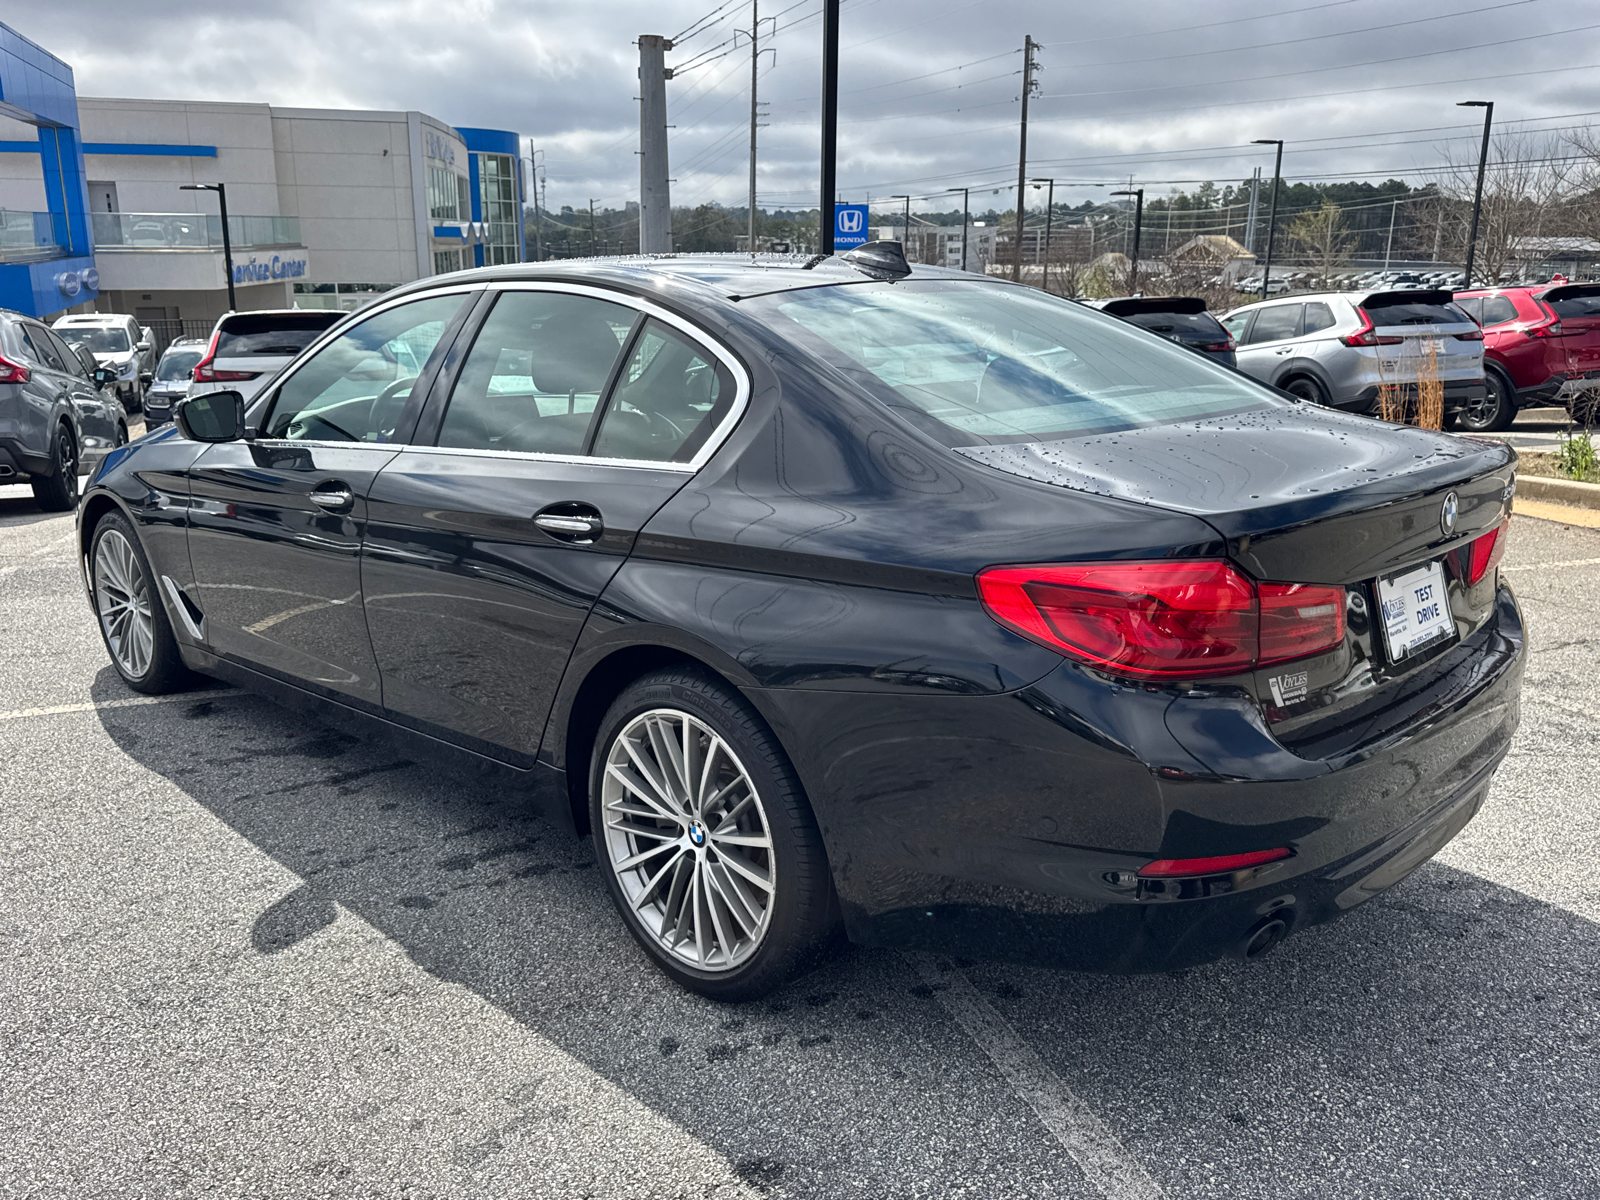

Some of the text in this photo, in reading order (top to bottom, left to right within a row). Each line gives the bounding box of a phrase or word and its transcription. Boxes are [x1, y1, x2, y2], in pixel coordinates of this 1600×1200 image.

[272, 255, 306, 279] Center
[1414, 584, 1433, 603] TEST
[1416, 603, 1440, 625] DRIVE
[1277, 674, 1307, 694] VOYLES
[682, 690, 732, 730] Cinturato
